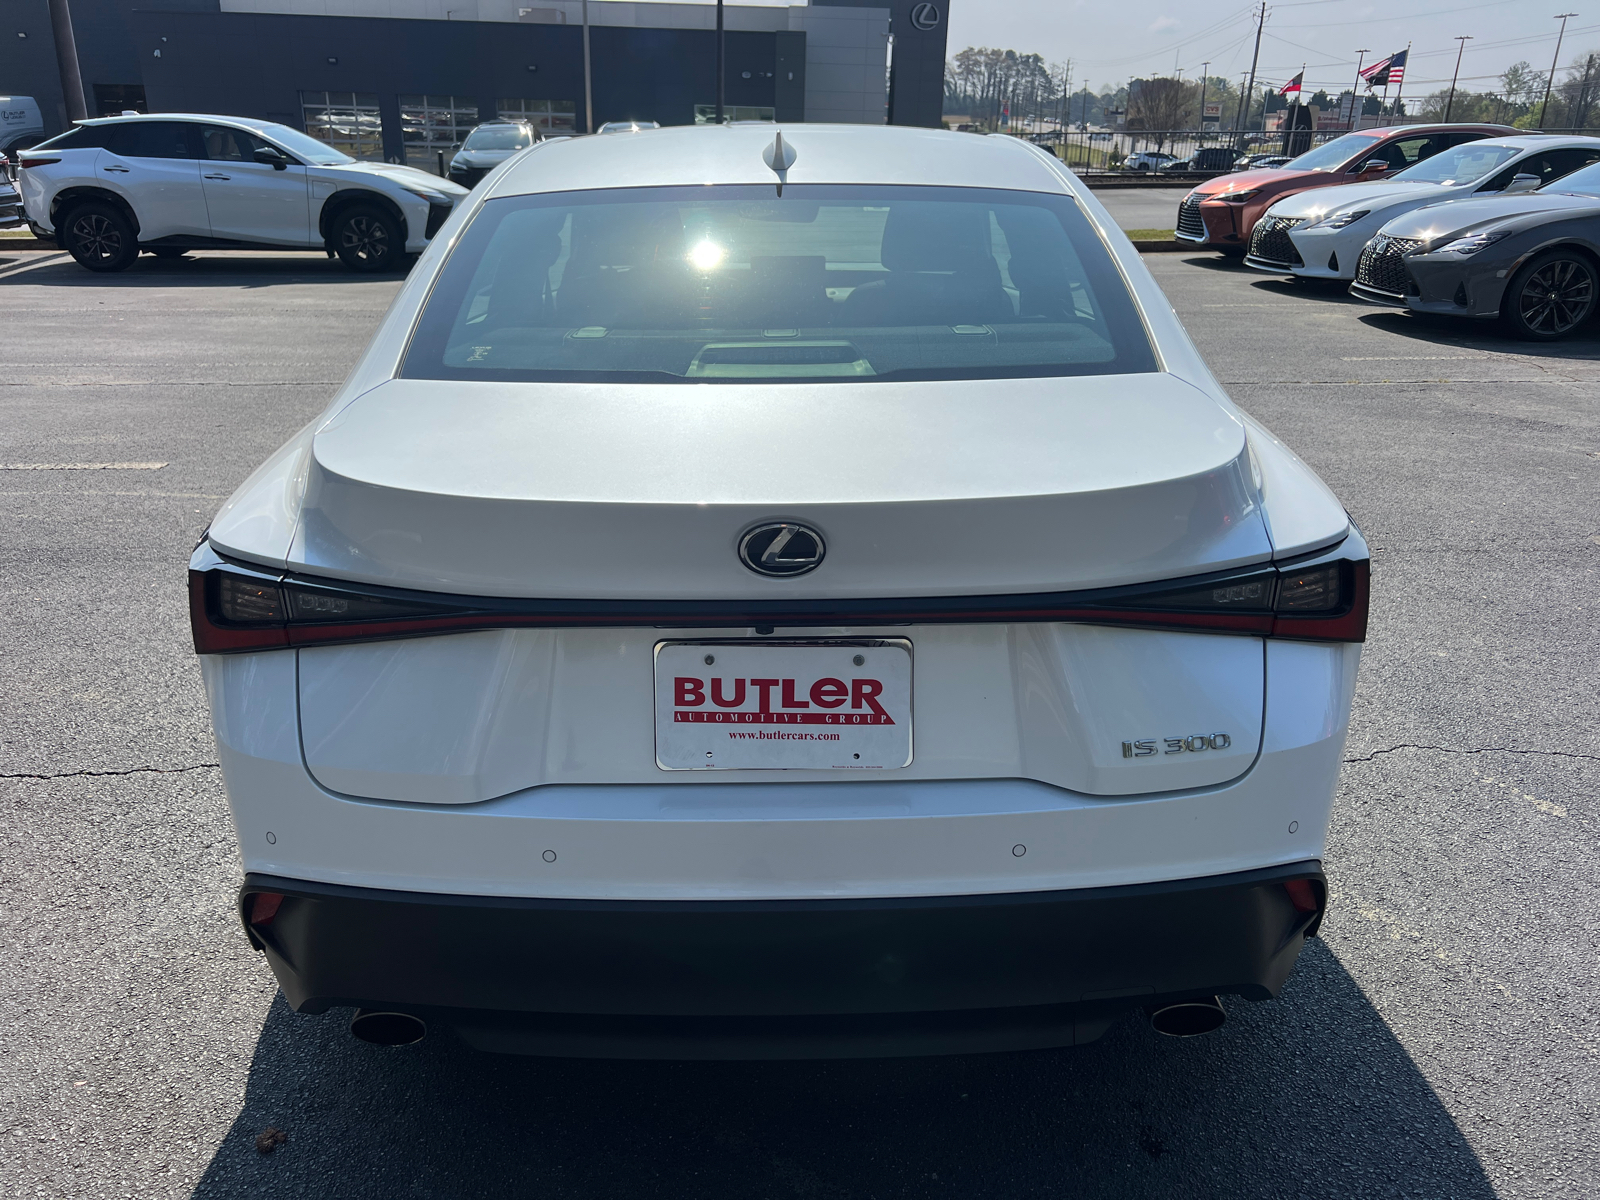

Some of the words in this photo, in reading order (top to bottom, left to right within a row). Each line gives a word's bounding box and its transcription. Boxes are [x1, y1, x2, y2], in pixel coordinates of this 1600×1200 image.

[675, 712, 803, 723] AUTOMOTIVE
[825, 714, 887, 724] GROUP
[729, 730, 840, 741] www.butlercars.com
[1122, 738, 1158, 758] IS
[1164, 731, 1231, 755] 300
